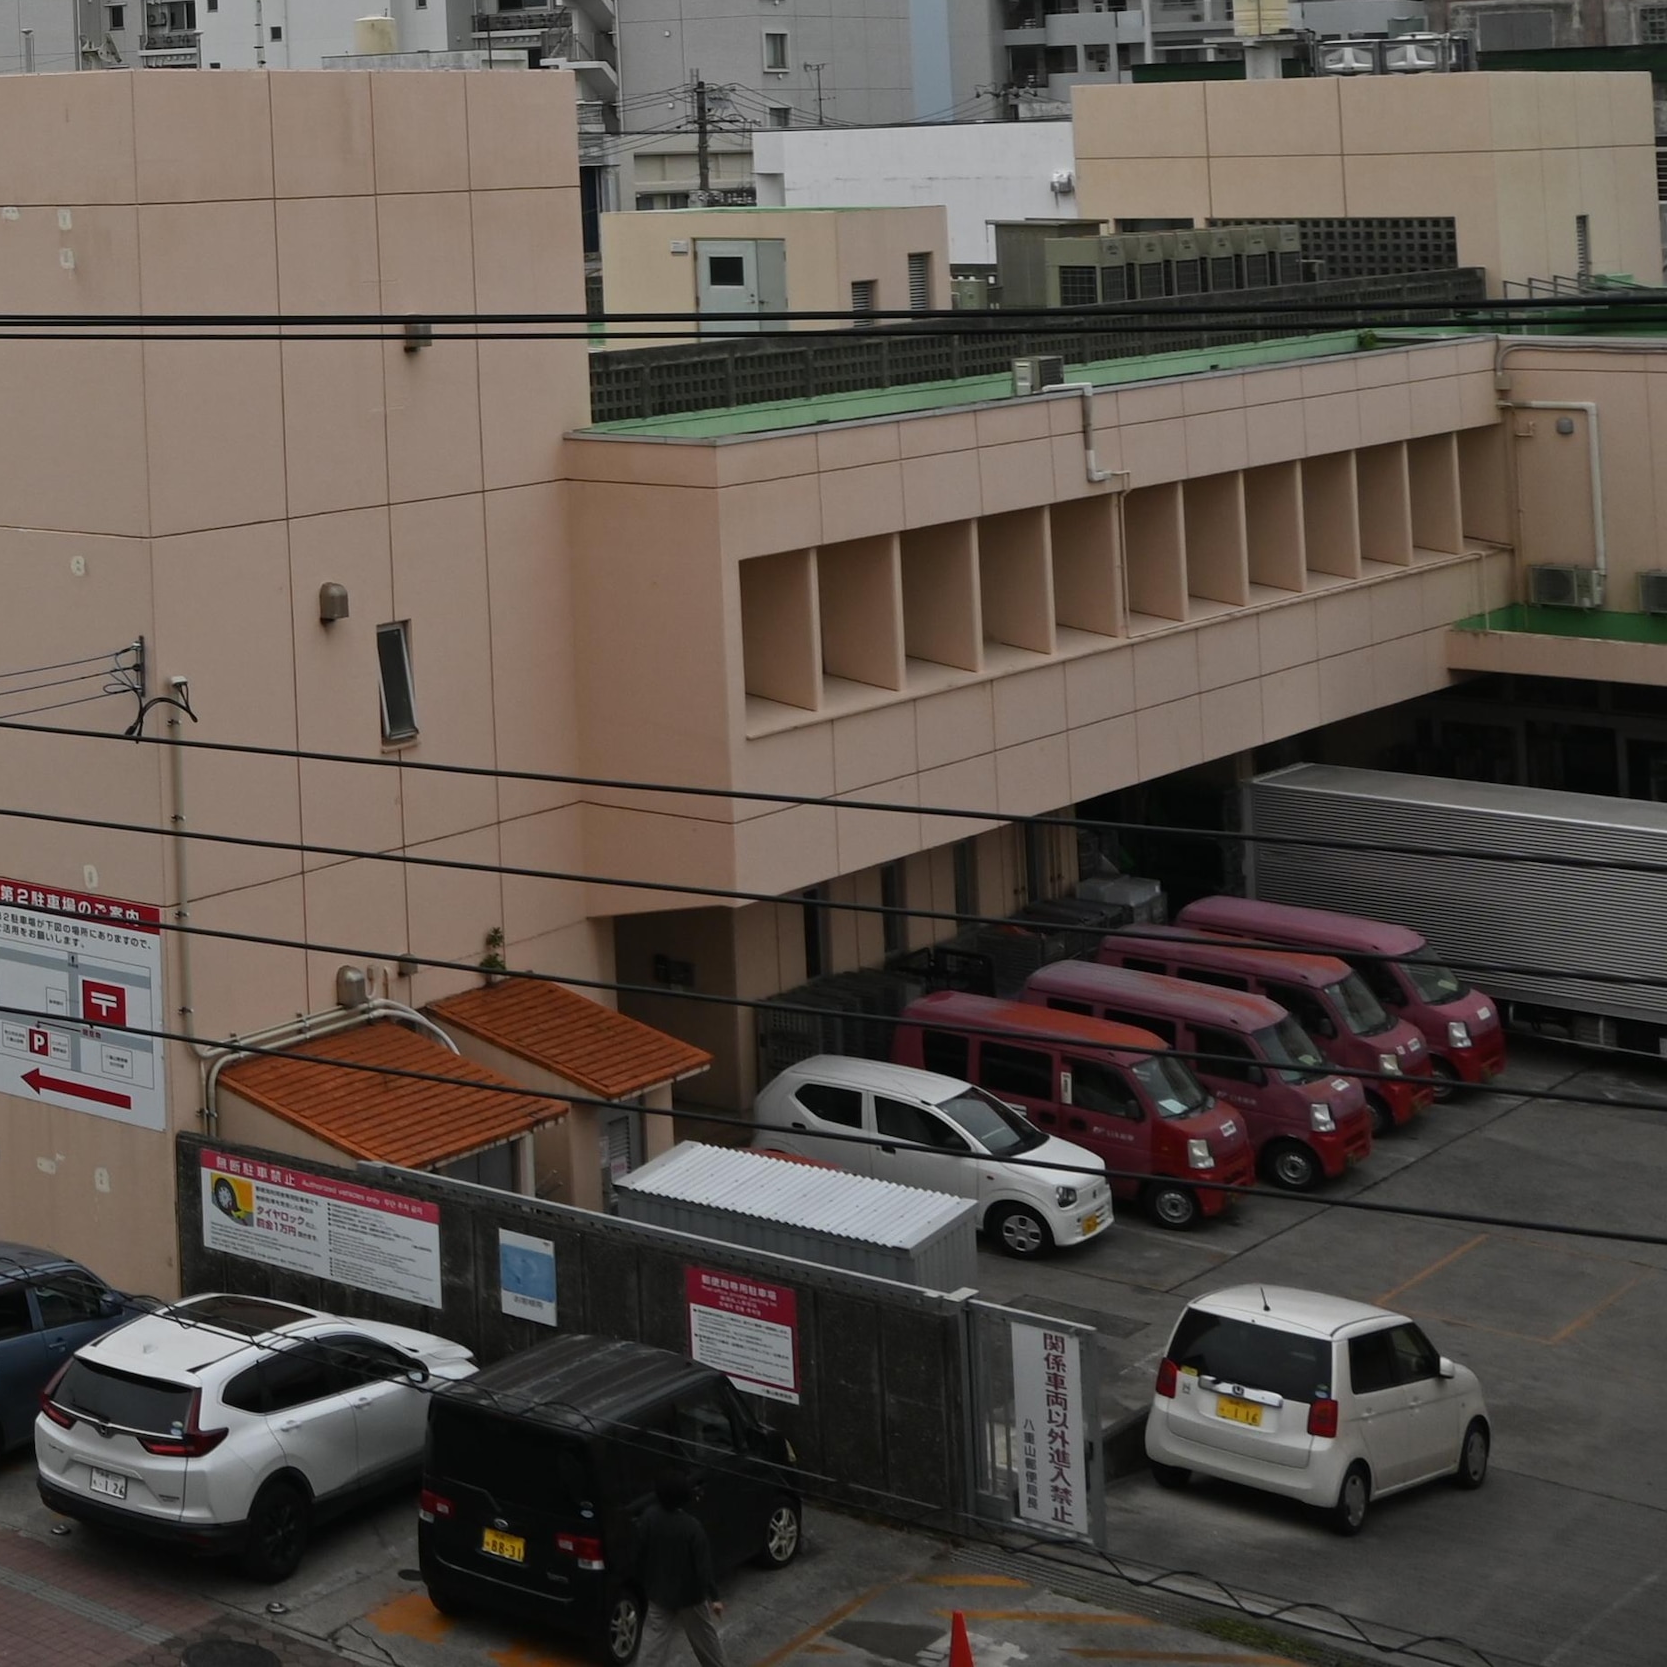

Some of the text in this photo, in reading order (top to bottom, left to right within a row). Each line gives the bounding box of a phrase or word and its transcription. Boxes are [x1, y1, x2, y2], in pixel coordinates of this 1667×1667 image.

[34, 1033, 47, 1052] P
[216, 1156, 296, 1187] 無断駐車禁止
[257, 1206, 305, 1225] タイヤロック
[1042, 1332, 1075, 1526] 関係車両以外進入禁止
